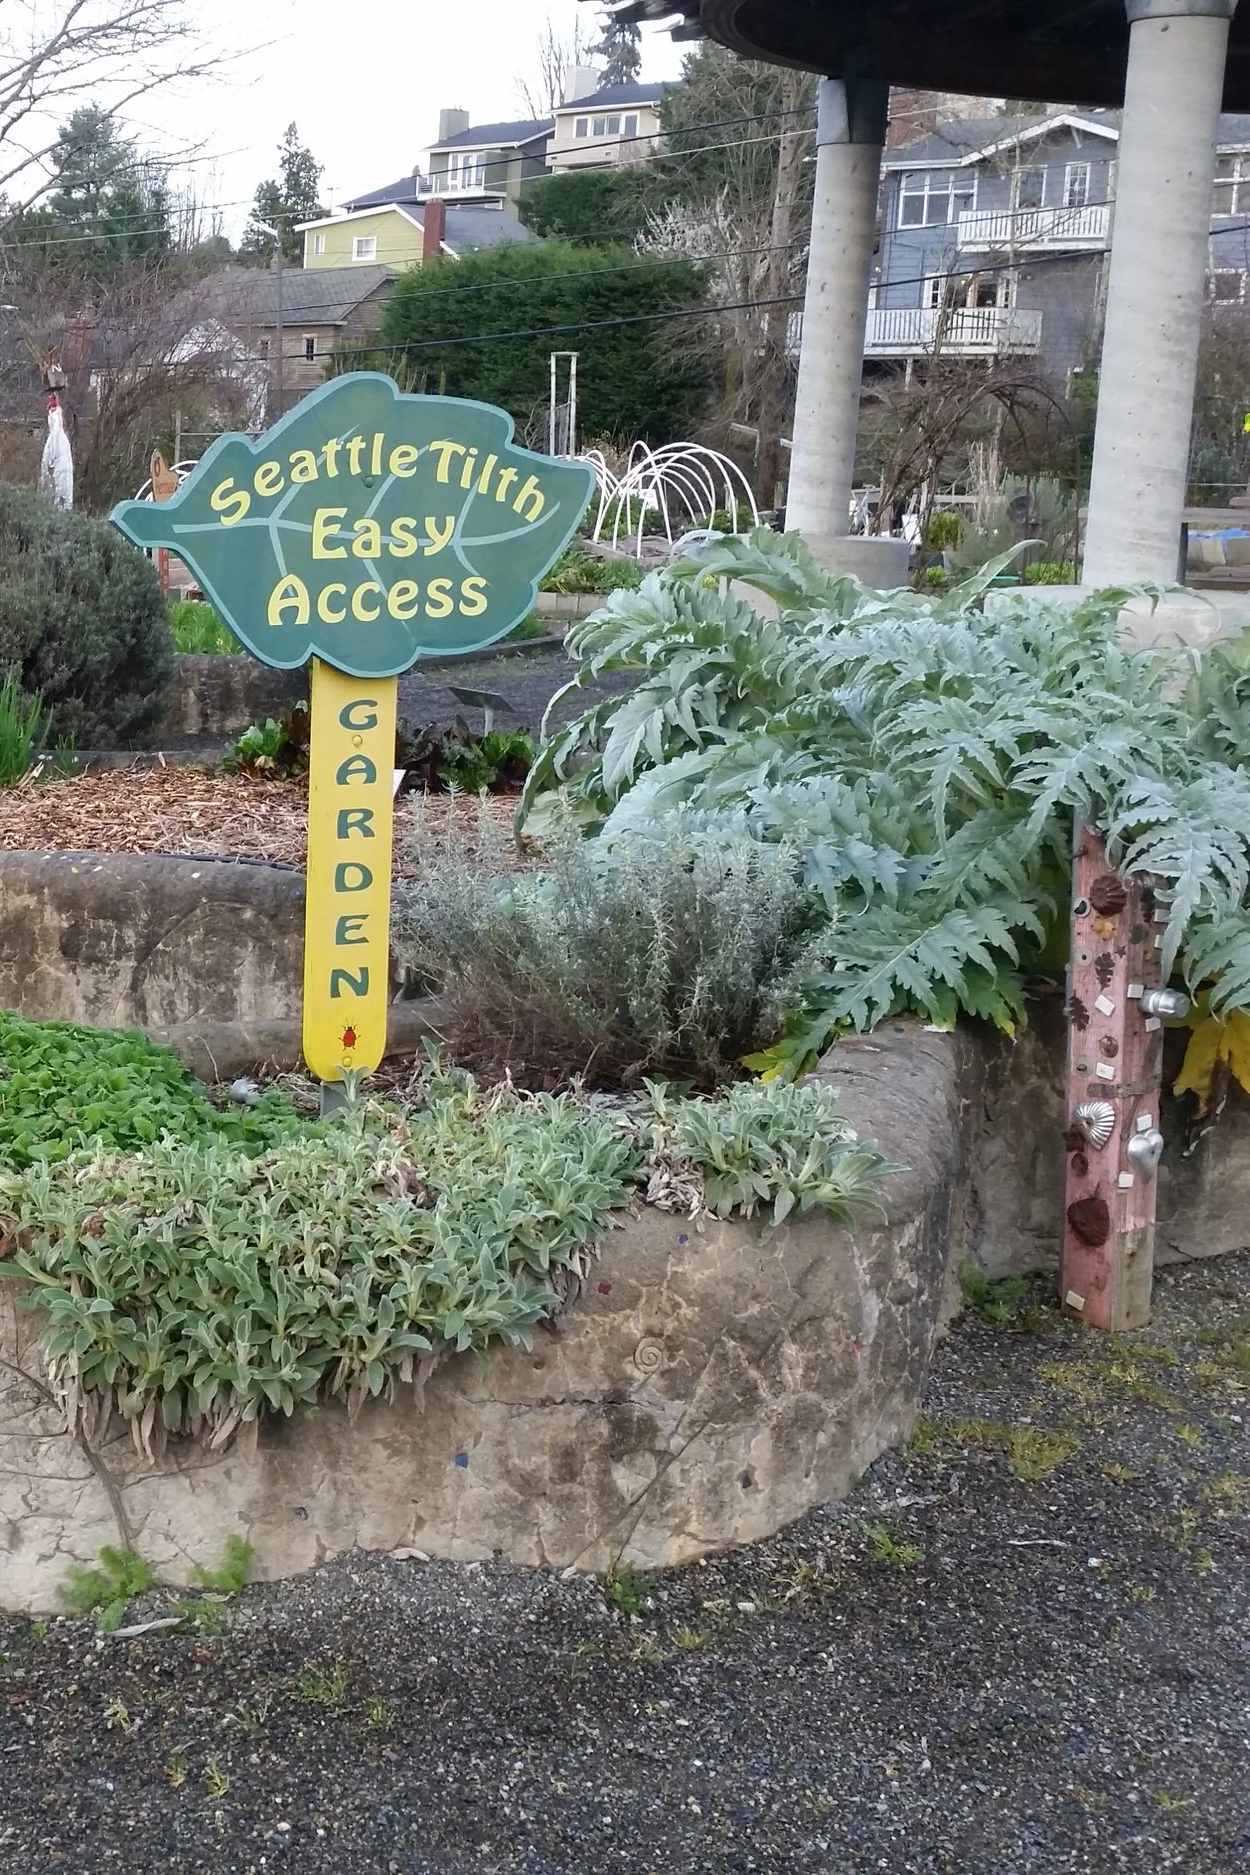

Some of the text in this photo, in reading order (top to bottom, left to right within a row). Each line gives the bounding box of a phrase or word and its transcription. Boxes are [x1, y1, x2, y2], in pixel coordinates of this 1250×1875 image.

[210, 433, 546, 526] Seattle Tilth
[312, 507, 455, 559] Easy
[267, 574, 489, 626] Access
[330, 699, 378, 998] GARDEN
